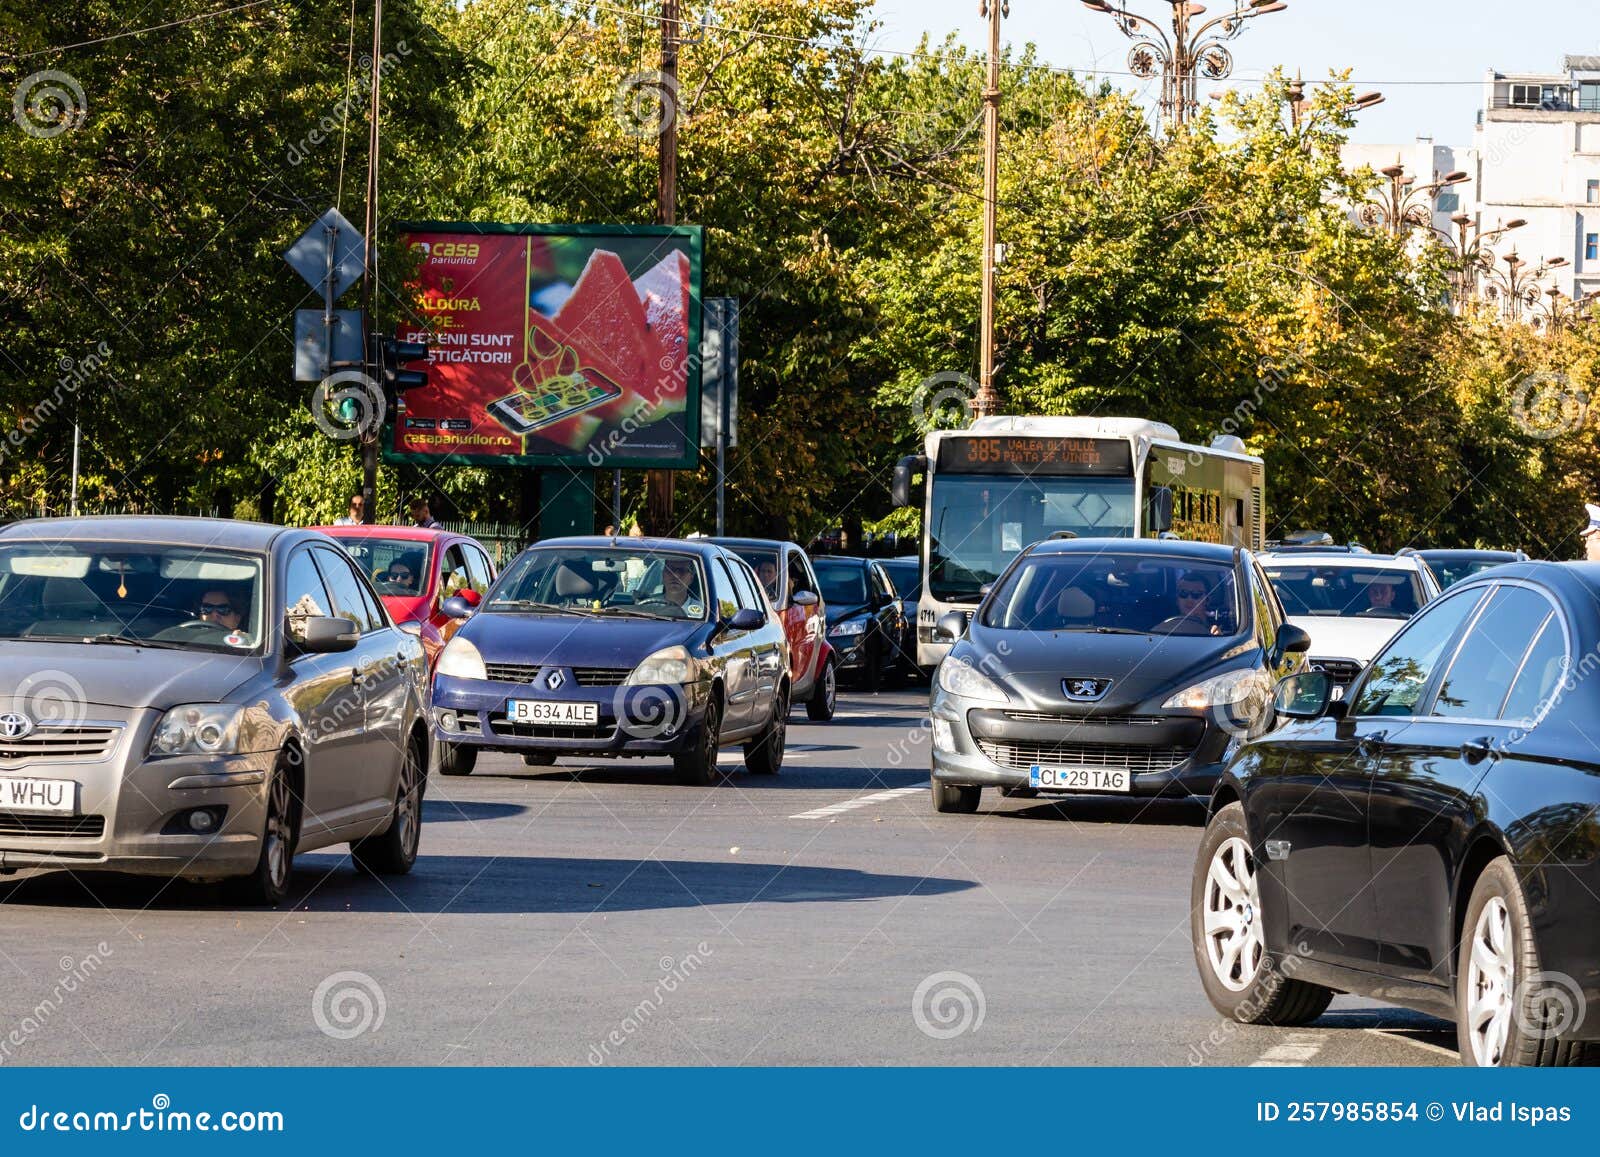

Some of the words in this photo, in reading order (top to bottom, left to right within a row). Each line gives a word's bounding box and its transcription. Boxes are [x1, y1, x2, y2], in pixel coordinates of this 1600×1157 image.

[432, 242, 480, 257] casa
[431, 256, 477, 265] pariurilor
[412, 294, 480, 311] ĂLDURĂ
[406, 332, 468, 345] PEENII
[470, 334, 514, 347] SUNT
[403, 433, 512, 446] casapariurilor.ro
[1007, 440, 1044, 451] VALEA
[967, 439, 1000, 462] 385
[518, 703, 528, 718] B
[534, 704, 560, 719] 634
[566, 705, 595, 721] ALE
[1041, 769, 1062, 786] CL
[1069, 770, 1089, 786] 29
[1092, 771, 1123, 788] TAG
[11, 781, 63, 806] WHU
